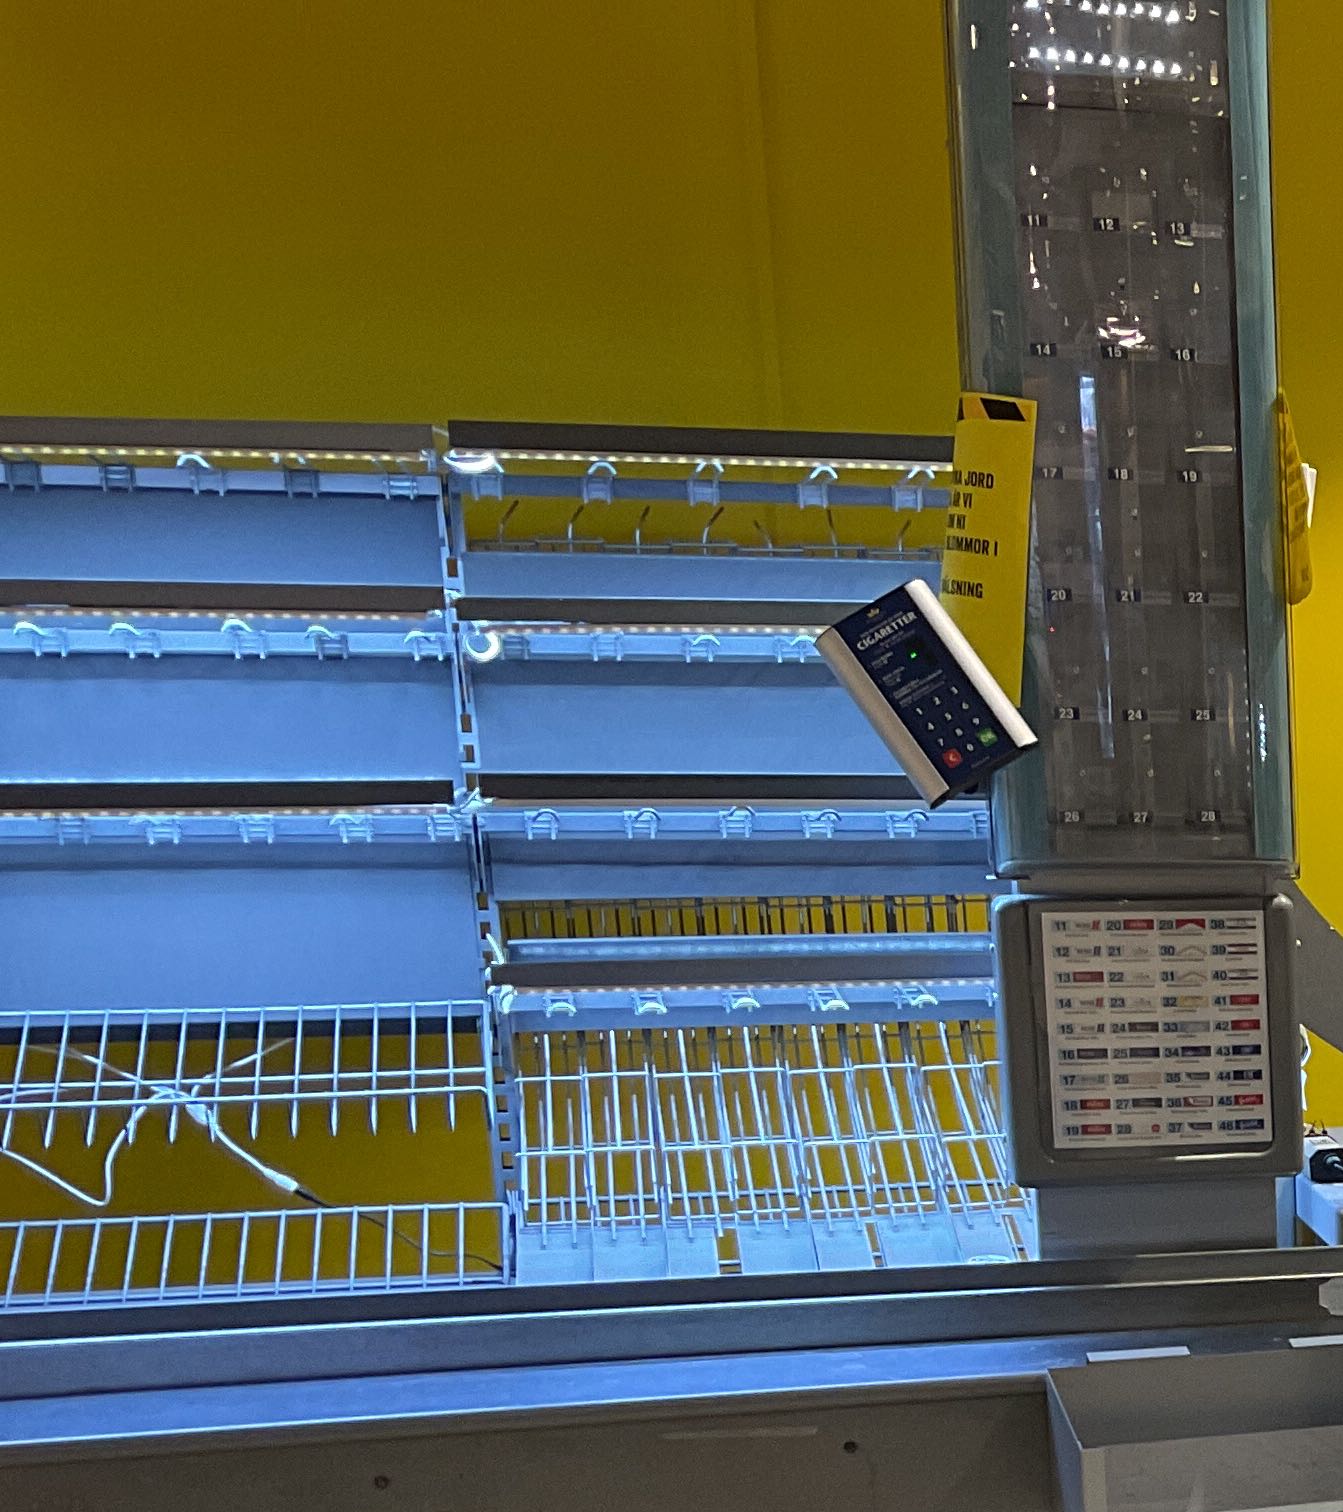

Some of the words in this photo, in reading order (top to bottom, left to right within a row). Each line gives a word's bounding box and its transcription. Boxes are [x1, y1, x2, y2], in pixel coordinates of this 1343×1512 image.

[1027, 214, 1041, 226] 11
[1098, 218, 1114, 231] 12
[1170, 222, 1185, 235] 13
[1035, 344, 1051, 356] 14
[1107, 346, 1122, 358] 15
[1175, 349, 1191, 361] 16
[1042, 468, 1057, 478] 17
[1113, 468, 1128, 480] 18
[1182, 471, 1198, 482] 19
[964, 470, 995, 489] JORD
[1051, 589, 1066, 601] 20
[1120, 591, 1135, 602] 21
[1188, 592, 1204, 603] 22
[856, 610, 918, 651] CIGARETTER
